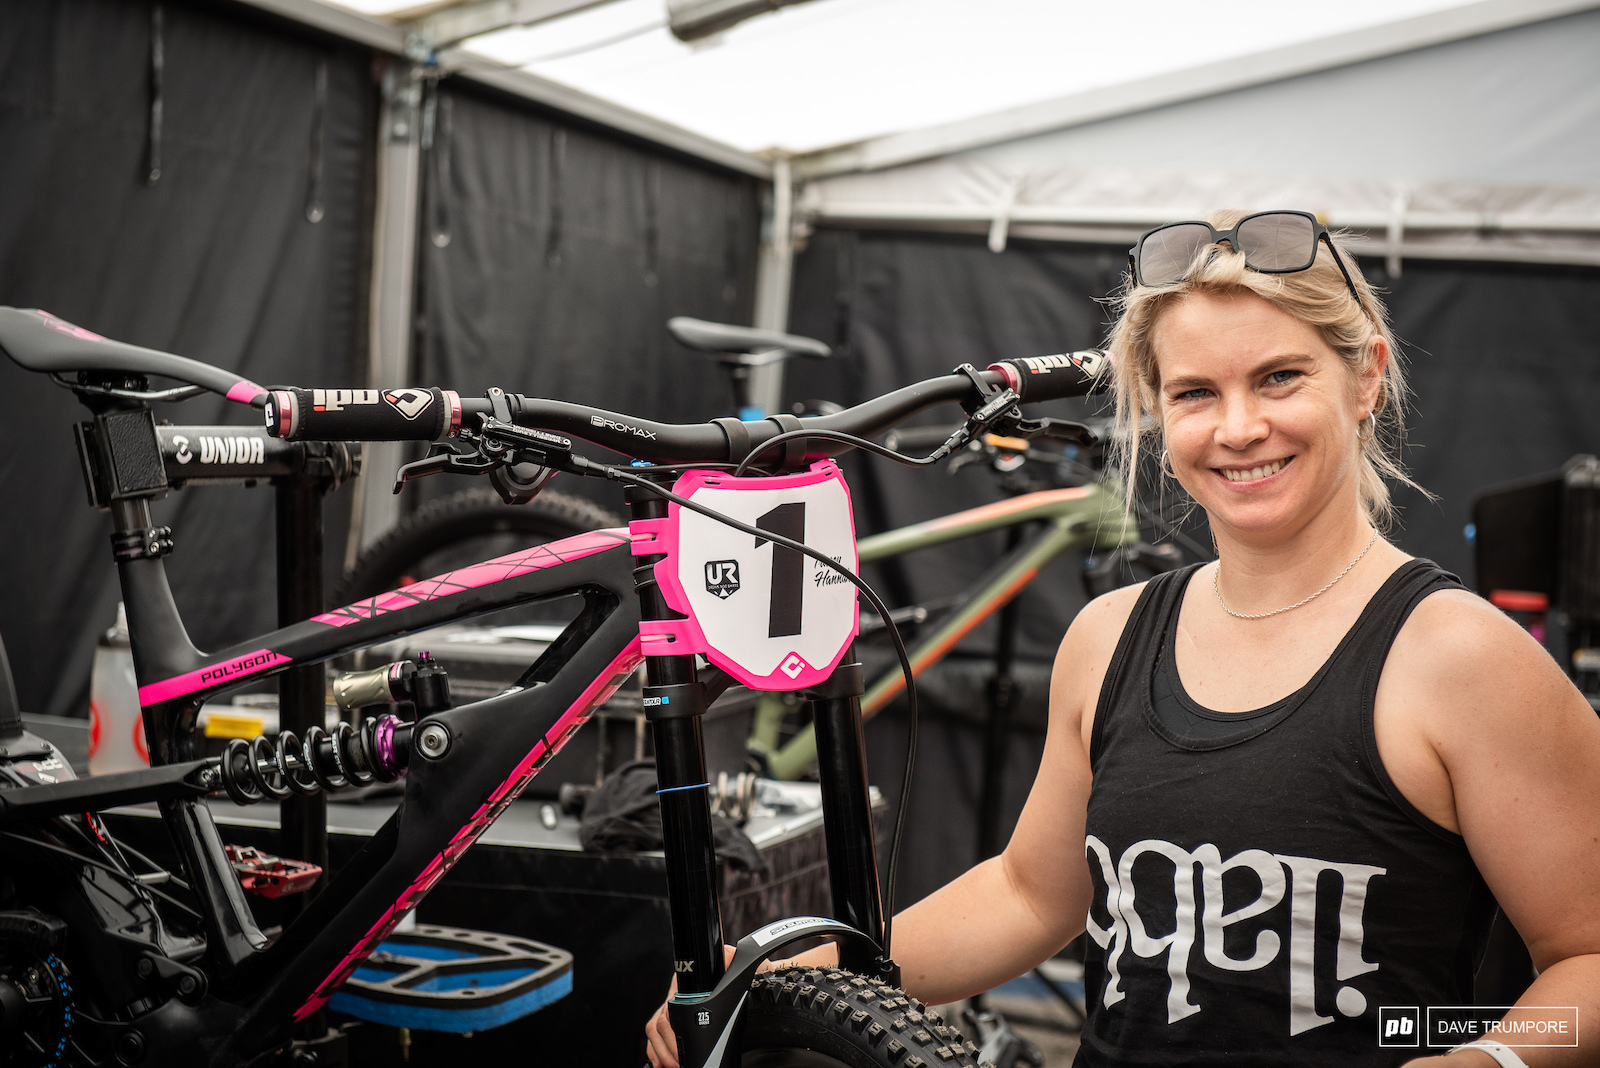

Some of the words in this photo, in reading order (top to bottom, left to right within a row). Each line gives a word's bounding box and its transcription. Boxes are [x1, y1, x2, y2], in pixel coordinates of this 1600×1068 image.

[200, 436, 265, 464] UNIOR
[754, 501, 806, 639] 1
[814, 568, 851, 588] Hanna
[200, 651, 279, 684] POLYGON
